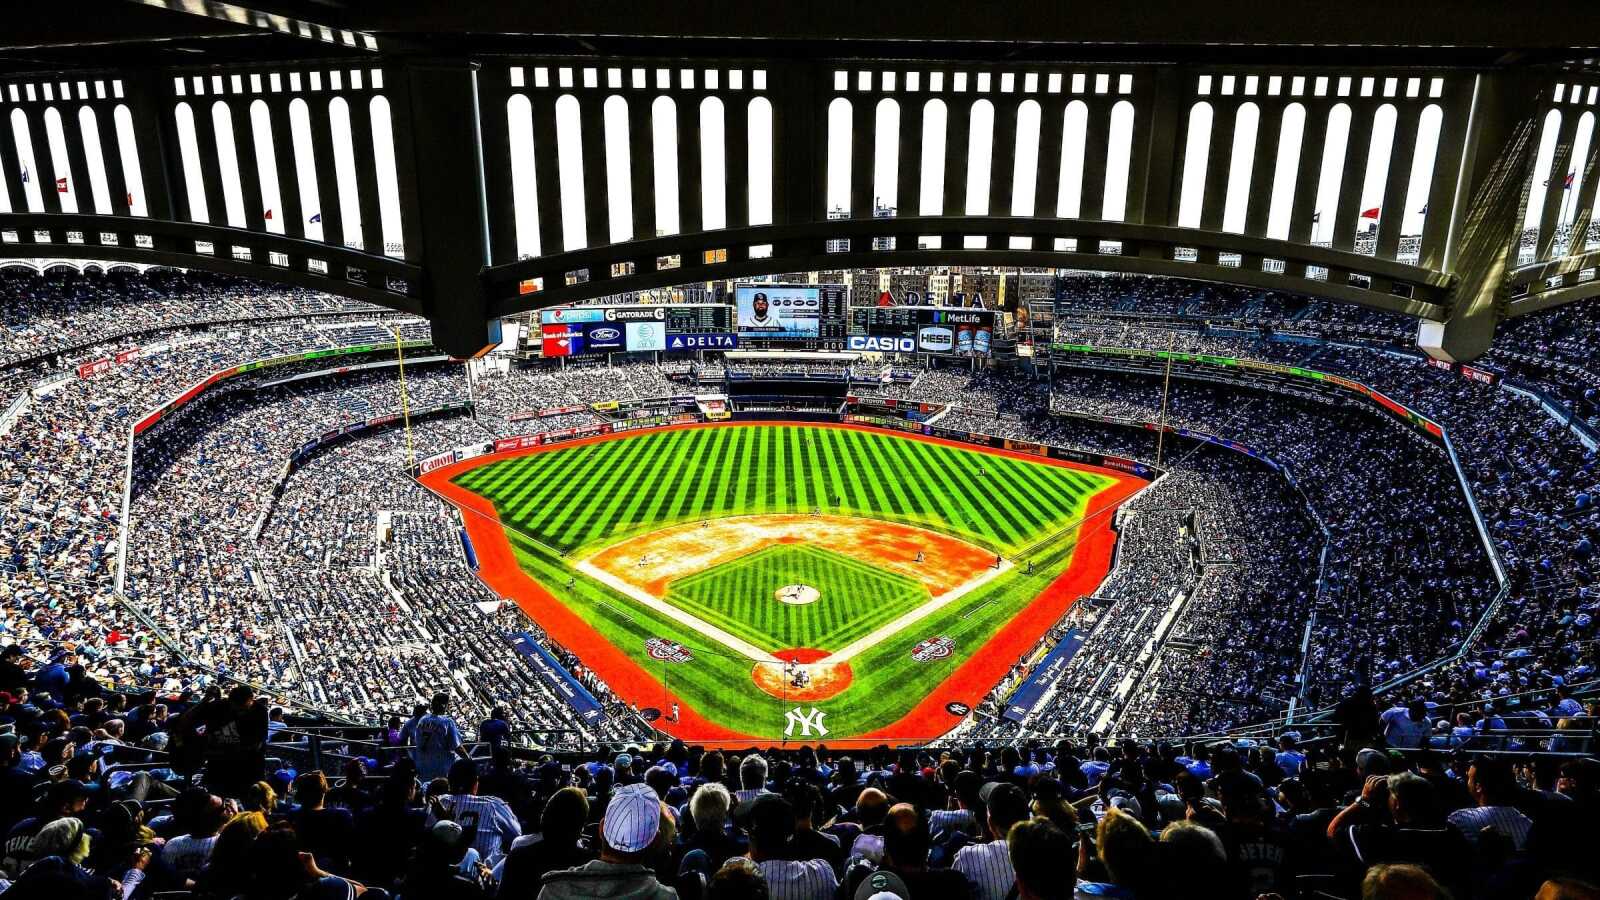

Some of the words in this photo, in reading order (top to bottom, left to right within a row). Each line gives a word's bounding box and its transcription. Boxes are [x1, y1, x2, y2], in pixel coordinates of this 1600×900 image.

[907, 291, 987, 310] DELTA
[947, 313, 980, 323] MetLife
[595, 330, 614, 339] Ford
[921, 334, 951, 344] HESS
[687, 337, 733, 346] DELTA
[850, 337, 915, 352] CASIO
[421, 454, 454, 473] Canon
